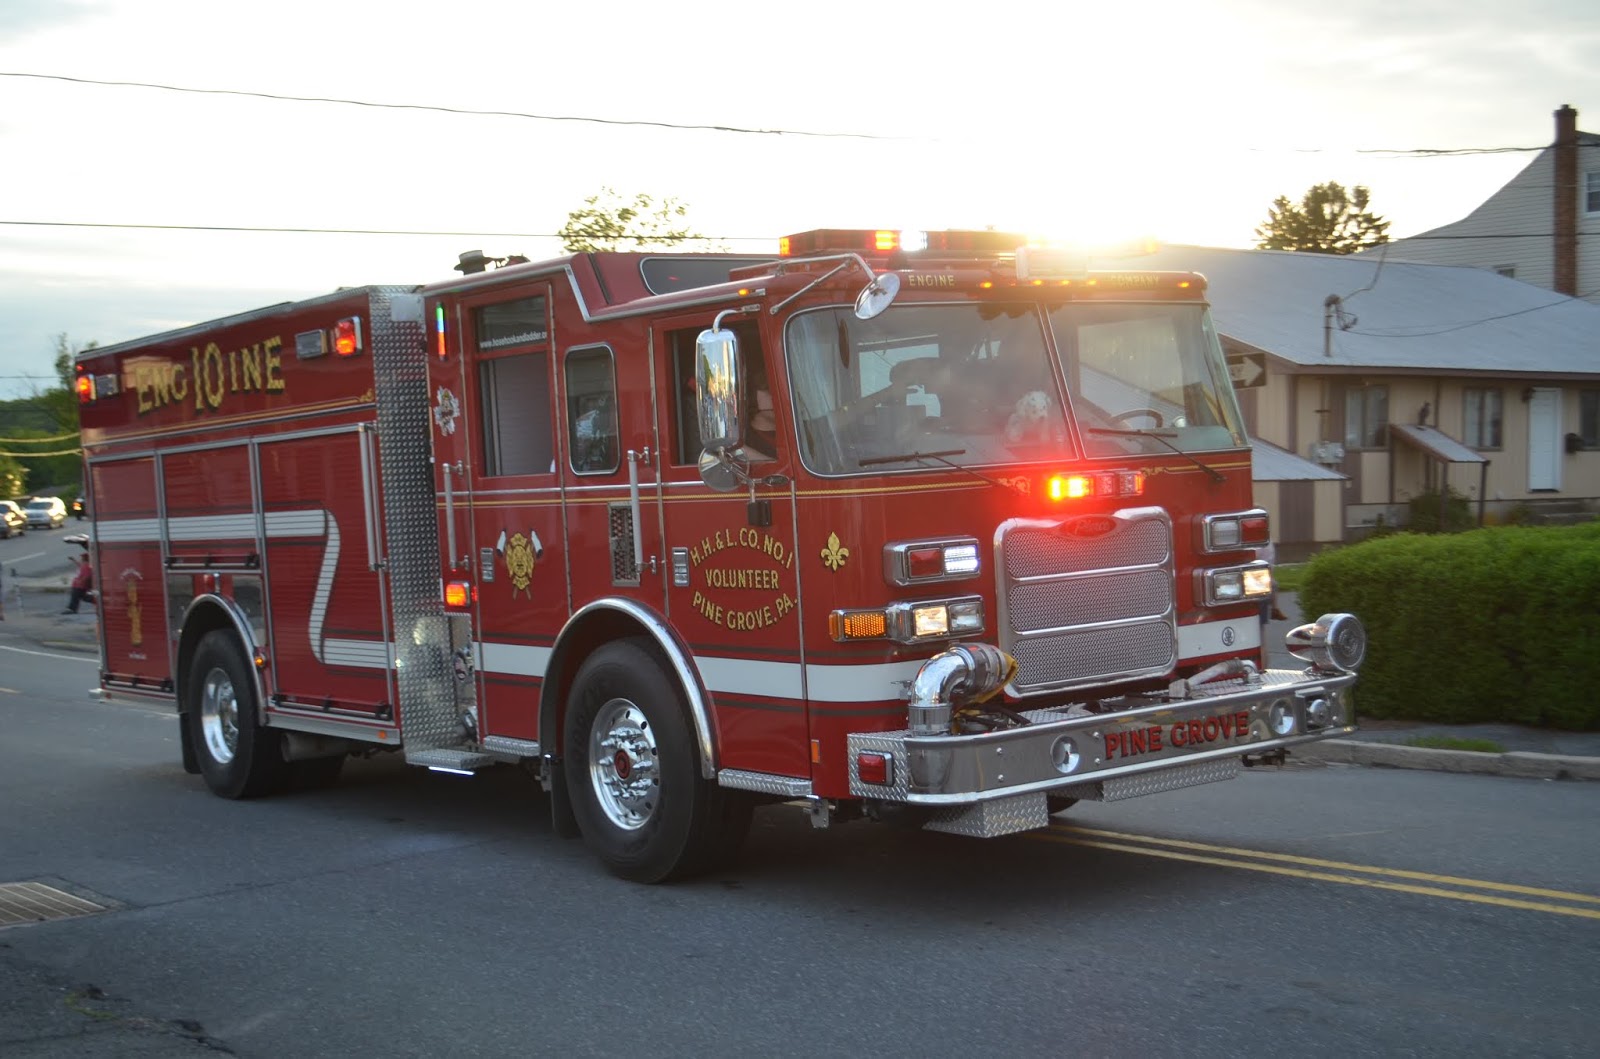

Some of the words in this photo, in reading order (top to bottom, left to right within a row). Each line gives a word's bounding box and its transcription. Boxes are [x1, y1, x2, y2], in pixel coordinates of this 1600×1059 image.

[908, 274, 955, 287] ENGINE
[136, 361, 188, 414] ENG
[230, 336, 286, 394] INE
[705, 568, 779, 589] VOLUNTEER
[692, 591, 724, 625] PINE
[1103, 725, 1164, 760] PINE
[1170, 711, 1249, 747] GROVE
